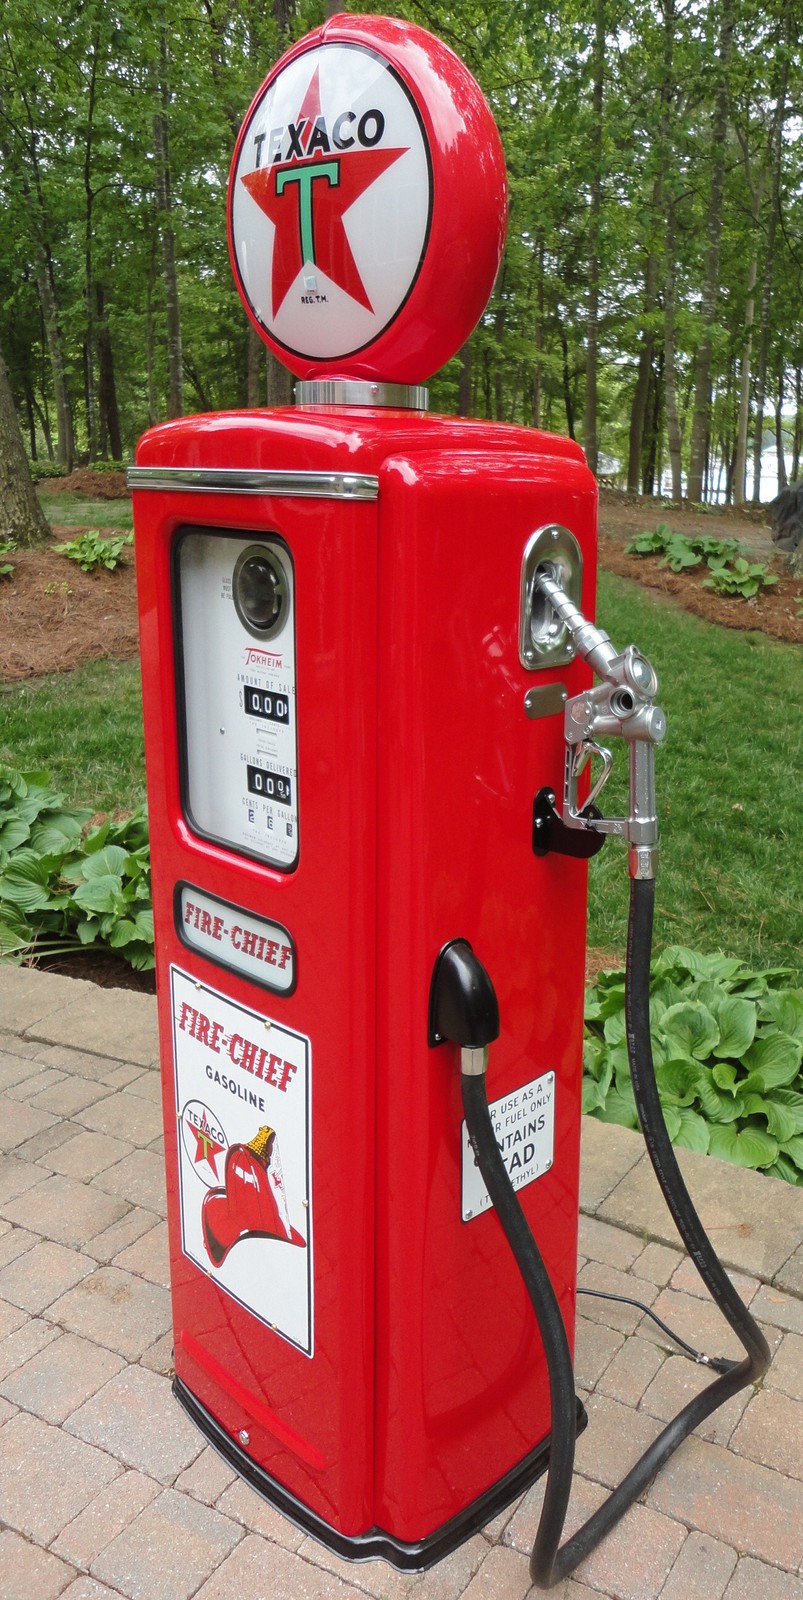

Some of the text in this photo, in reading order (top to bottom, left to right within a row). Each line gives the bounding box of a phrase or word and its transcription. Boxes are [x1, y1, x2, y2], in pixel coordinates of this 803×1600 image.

[253, 108, 386, 169] TEXACO
[275, 159, 340, 266] T
[245, 647, 283, 669] TOKHEIM
[237, 673, 261, 686] AMOUNT
[266, 680, 274, 690] OF
[240, 752, 297, 778] GALLONS DELIVERED
[242, 797, 259, 810] CENTS
[262, 804, 273, 815] PER
[184, 901, 293, 970] FIRE-CHIEF
[177, 1001, 298, 1093] FIRE-CHIEF
[205, 1064, 265, 1113] GASOLINE
[500, 1083, 543, 1115] USE AS A
[187, 1108, 225, 1145] TEXACO
[505, 1108, 528, 1128] FUEL
[530, 1092, 552, 1112] ONLY
[196, 1129, 214, 1160] T
